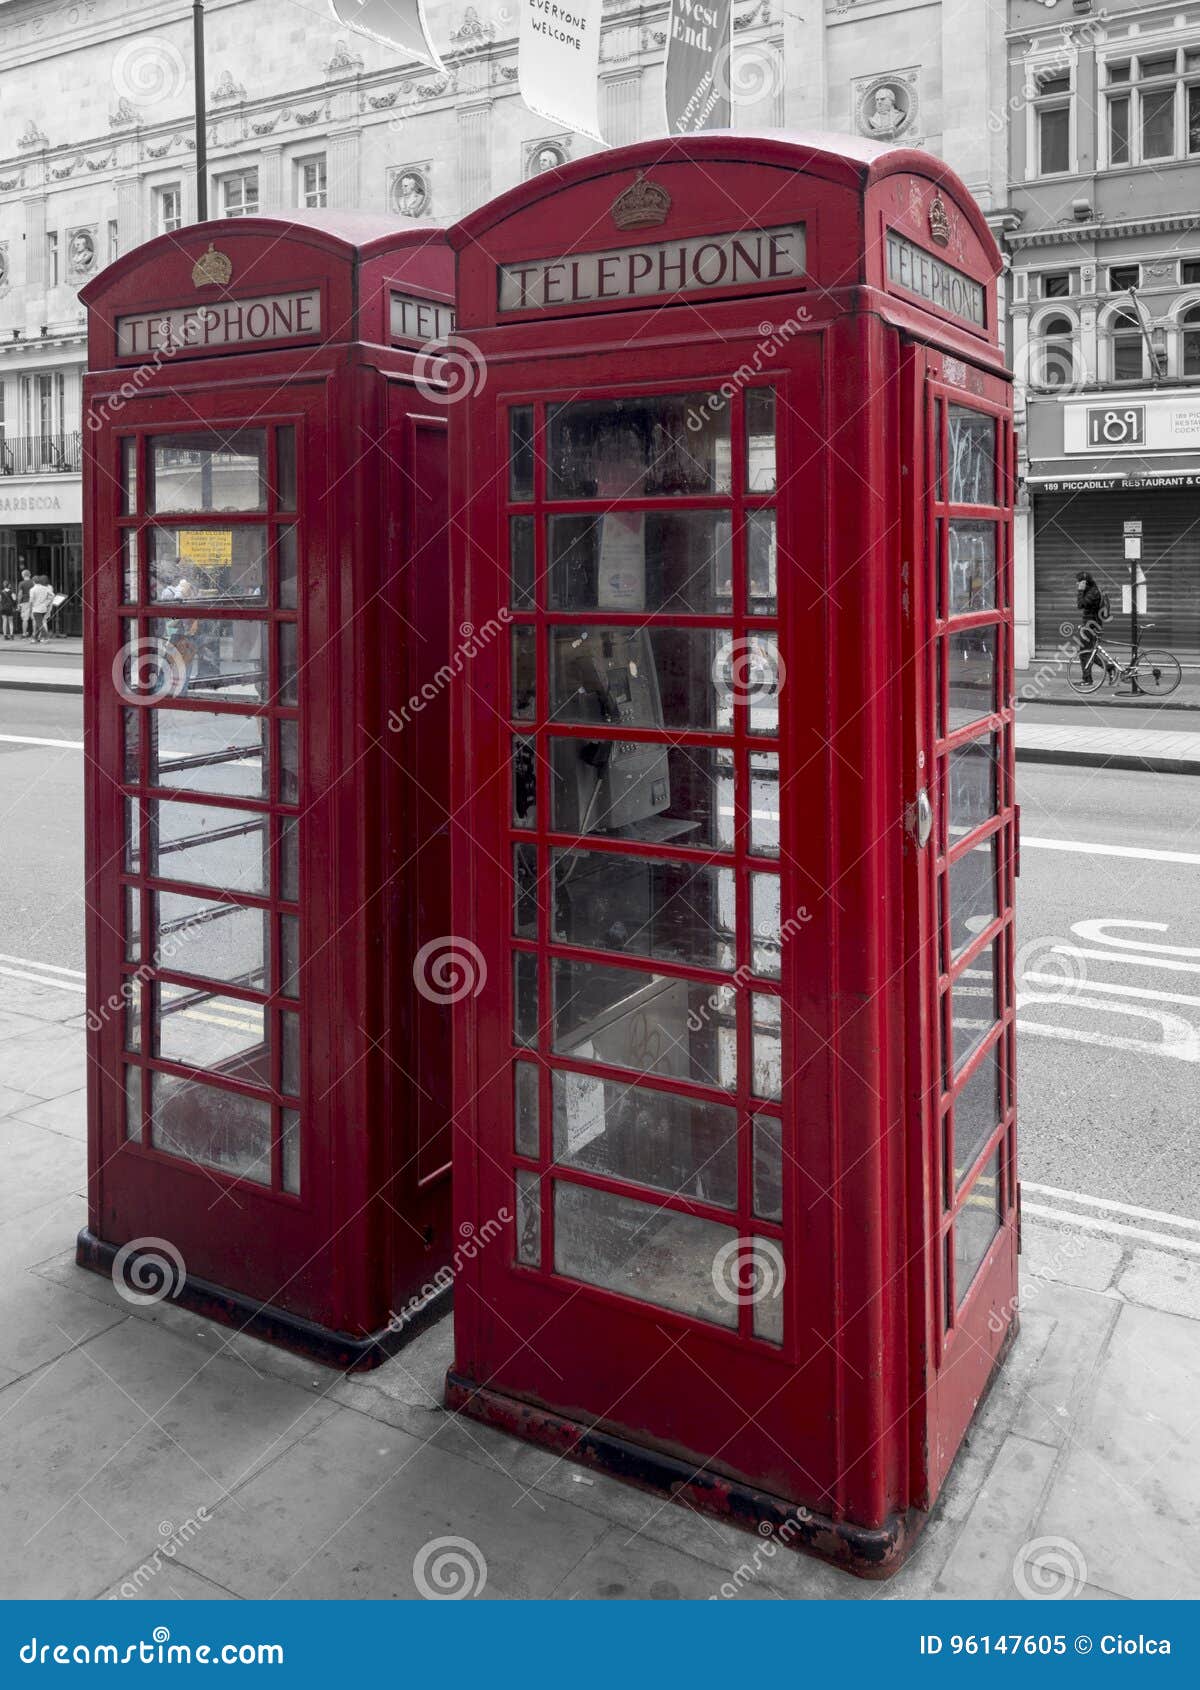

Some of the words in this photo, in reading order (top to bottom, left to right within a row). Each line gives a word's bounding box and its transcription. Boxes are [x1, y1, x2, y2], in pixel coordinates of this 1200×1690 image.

[530, 0, 586, 30] EVERYONE
[532, 16, 581, 50] WELCOME
[672, 16, 712, 52] End.
[676, 71, 713, 132] Everyone
[694, 88, 719, 131] elcome
[511, 232, 794, 307] TELEPHONE
[888, 239, 981, 324] TELEPHONE
[125, 296, 313, 353] TELEPHONE
[1093, 410, 1138, 442] 189
[1044, 482, 1059, 491] 189
[1063, 480, 1115, 490] PICCADILLY
[1122, 477, 1185, 488] RESTAURANT
[1186, 476, 1194, 485] &
